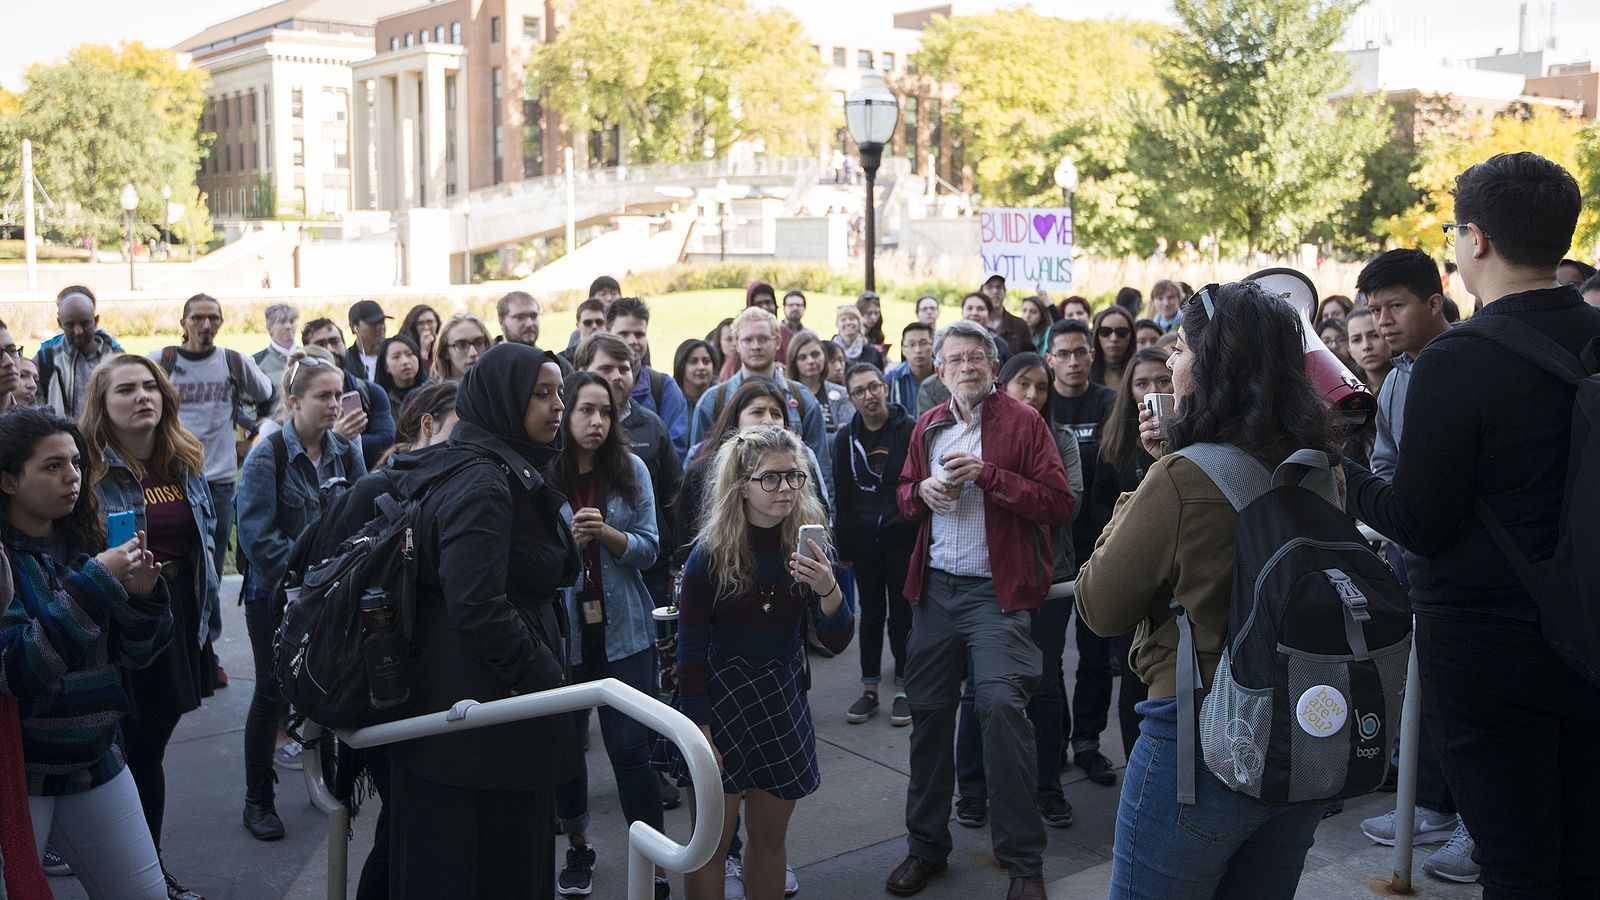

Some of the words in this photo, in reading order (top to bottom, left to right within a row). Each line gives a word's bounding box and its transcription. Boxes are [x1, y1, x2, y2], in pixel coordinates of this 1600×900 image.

[981, 212, 1027, 243] BUILD
[981, 252, 1021, 282] NOT
[1023, 255, 1072, 283] WALLS
[144, 484, 184, 505] onse
[1309, 697, 1330, 718] are
[1317, 687, 1344, 716] how
[1299, 704, 1333, 733] you?
